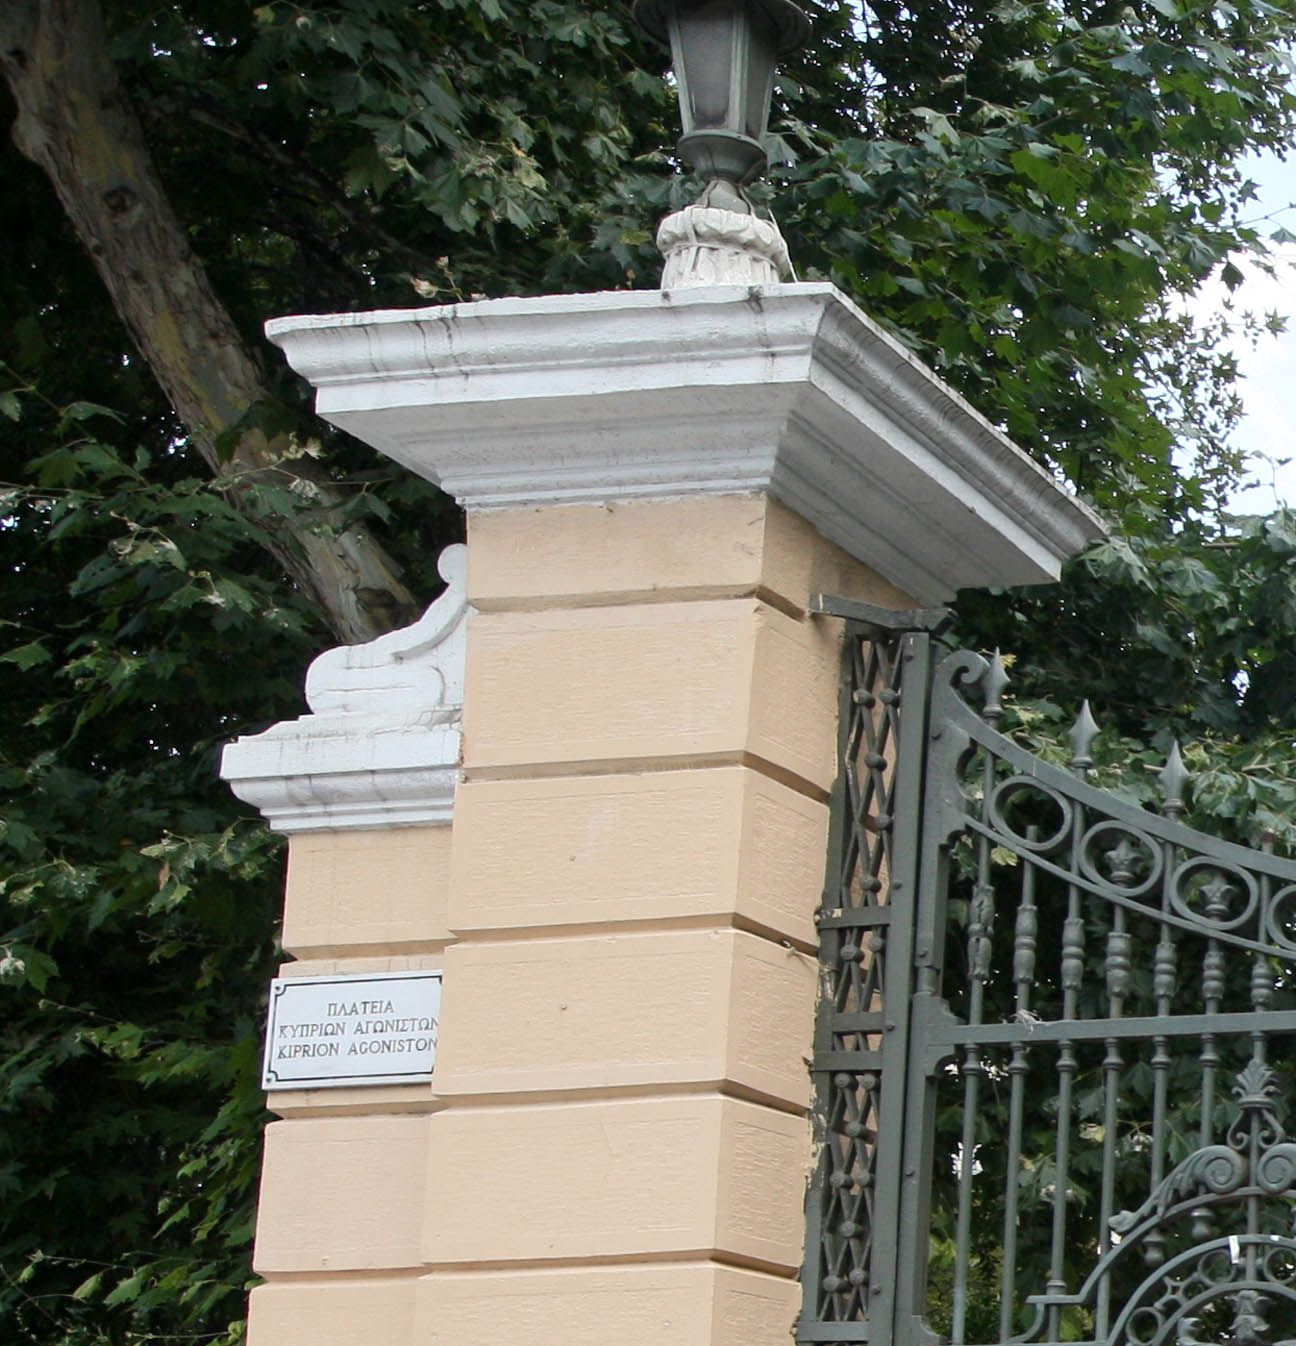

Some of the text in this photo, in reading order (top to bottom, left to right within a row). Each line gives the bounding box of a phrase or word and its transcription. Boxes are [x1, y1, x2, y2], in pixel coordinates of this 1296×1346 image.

[327, 1000, 395, 1017] ΠΛΑΤΕΙΑ
[278, 1021, 346, 1038] ΚΥΠΡΙΩΝ
[277, 1042, 340, 1060] KIPRION
